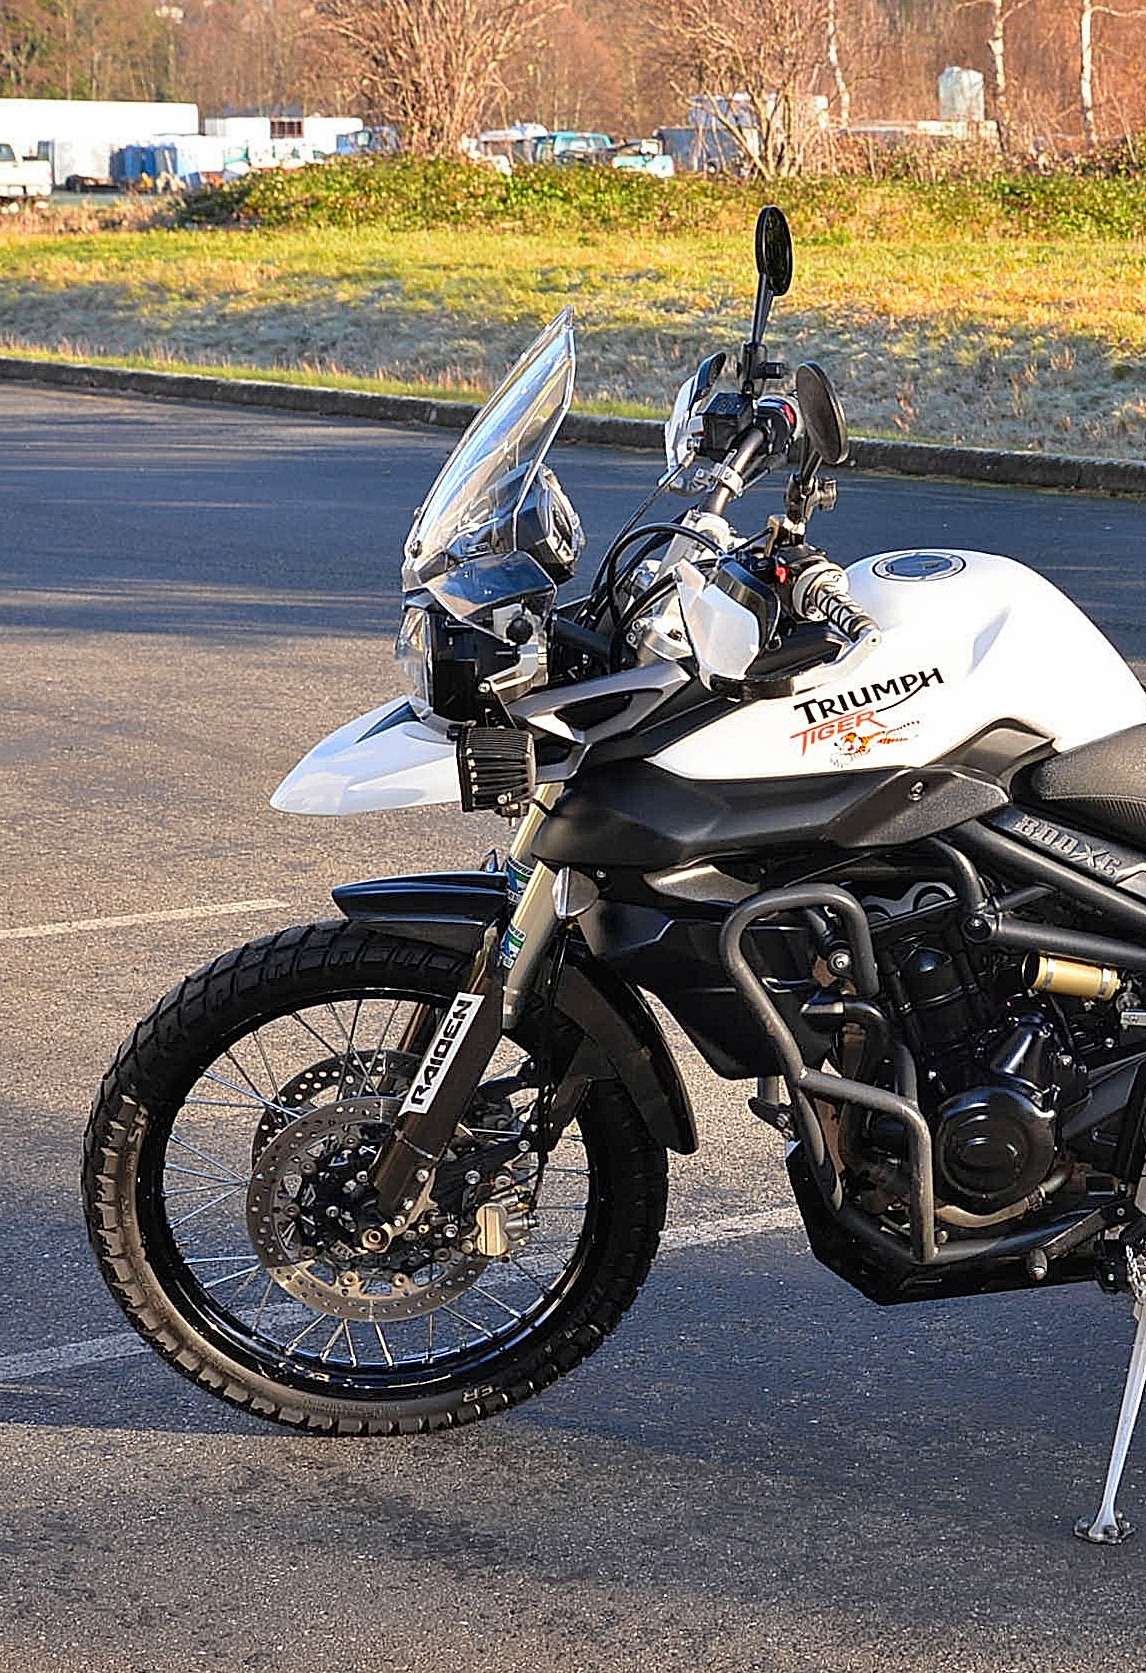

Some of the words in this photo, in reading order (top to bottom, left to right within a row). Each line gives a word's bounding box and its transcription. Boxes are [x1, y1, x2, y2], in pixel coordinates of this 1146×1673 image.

[793, 667, 945, 725] TRIUMPH
[789, 708, 888, 757] TIGER
[410, 998, 473, 1106] RAIDEN
